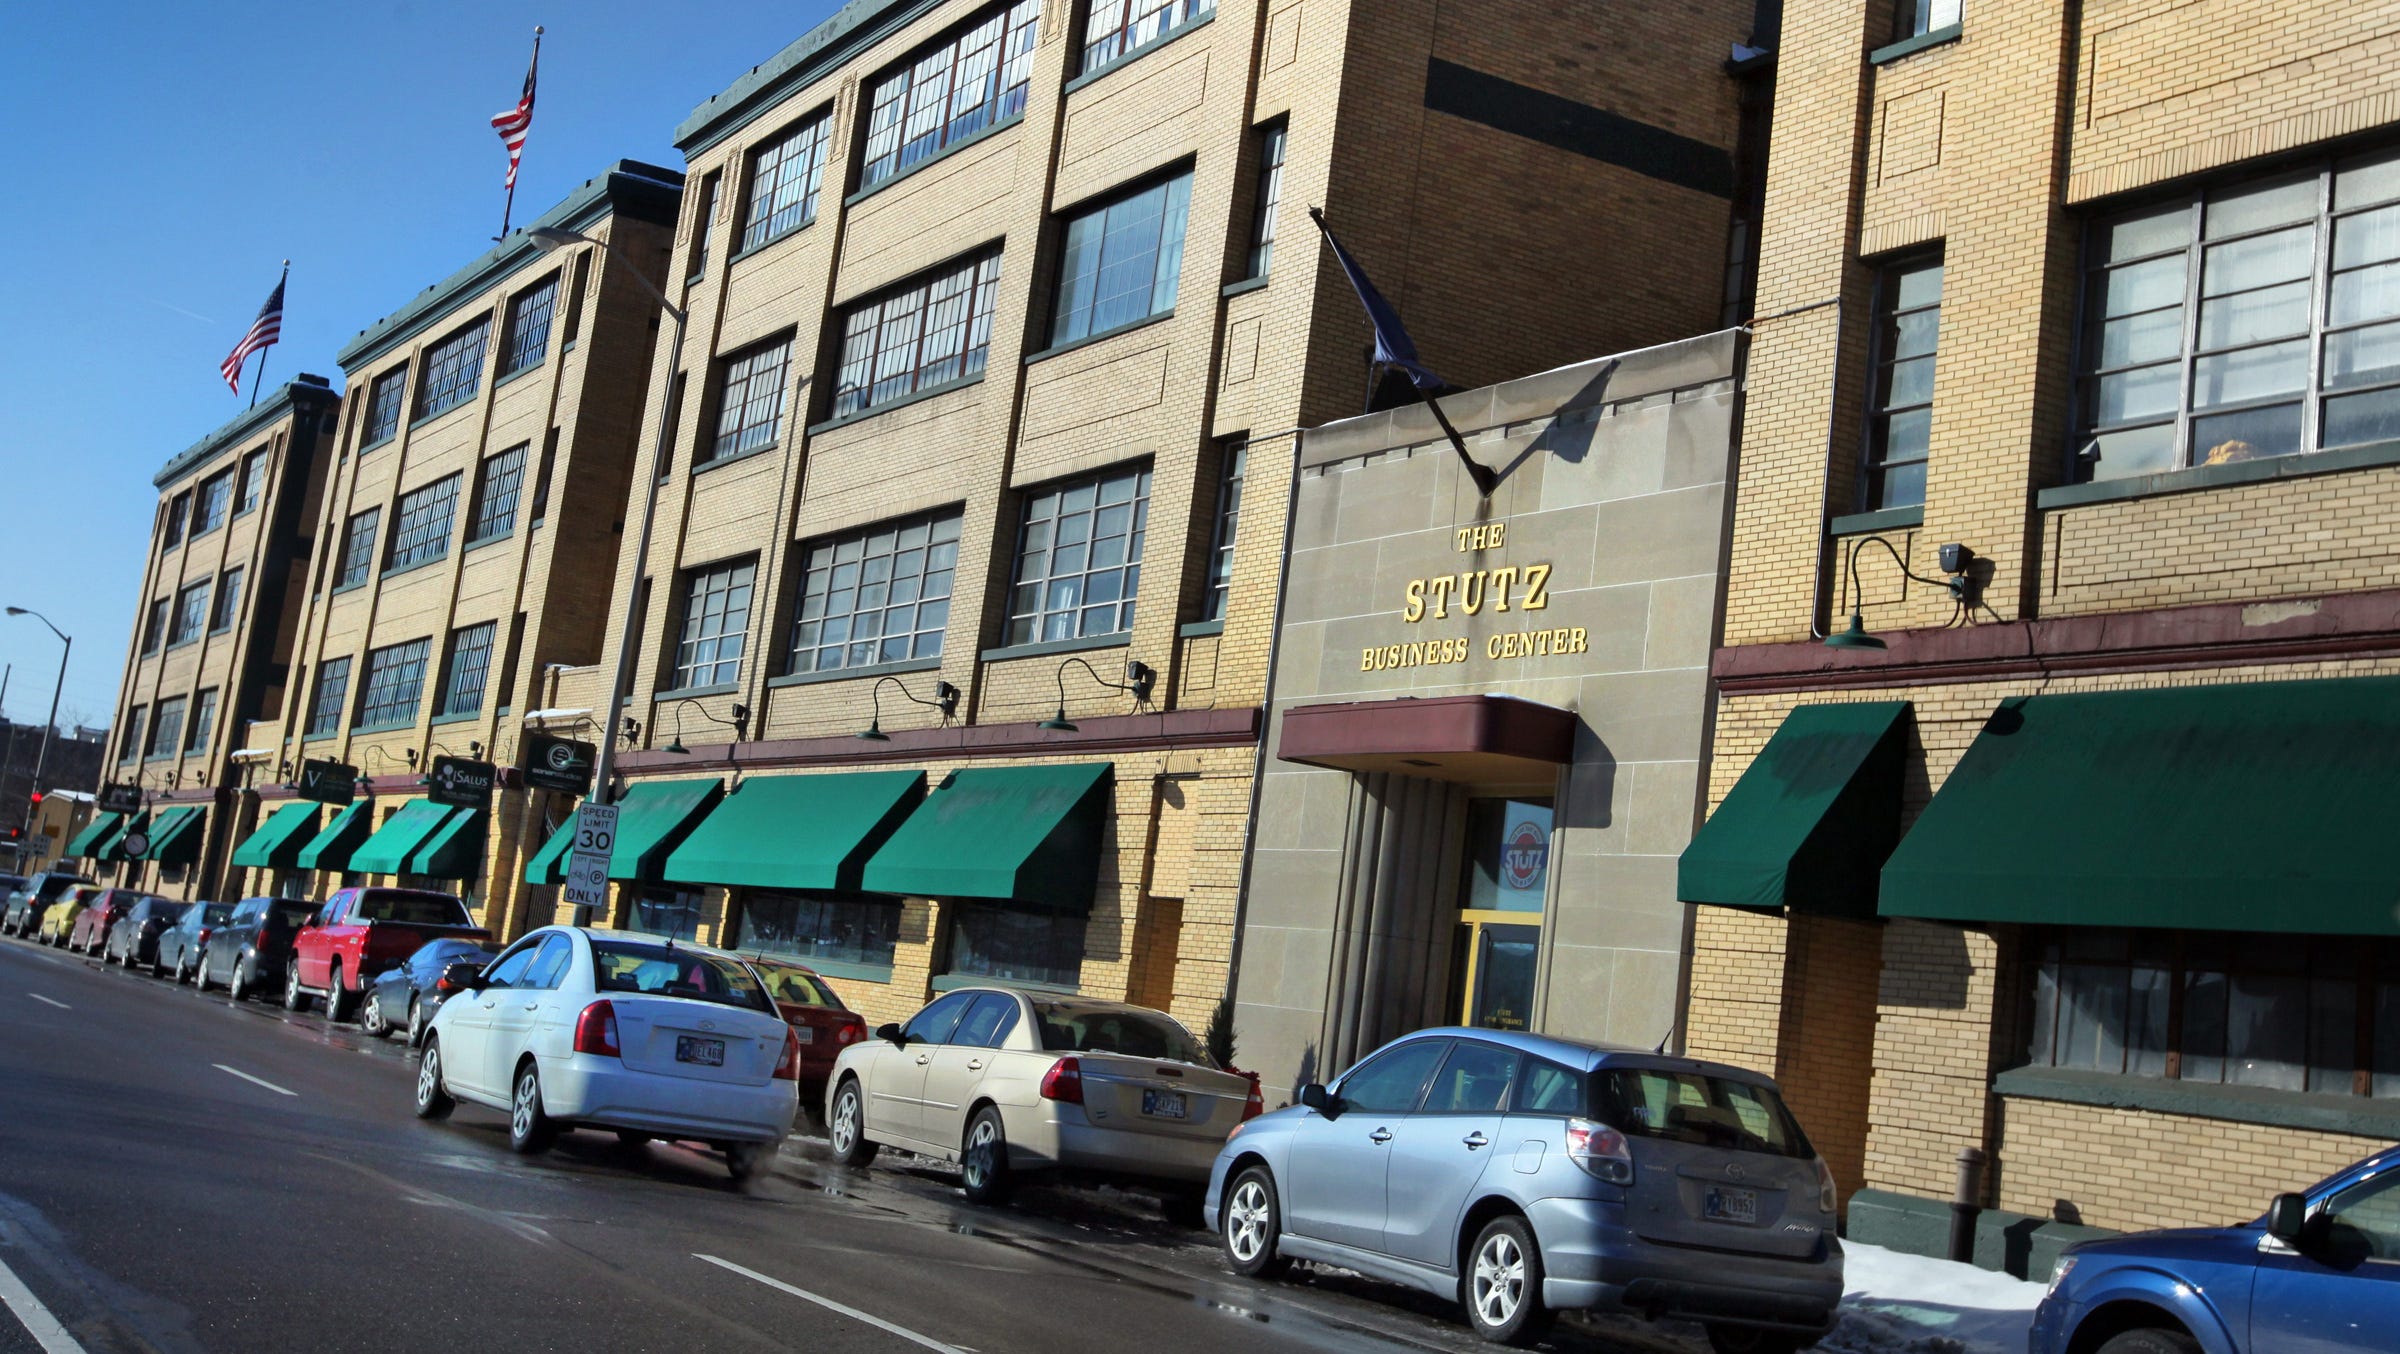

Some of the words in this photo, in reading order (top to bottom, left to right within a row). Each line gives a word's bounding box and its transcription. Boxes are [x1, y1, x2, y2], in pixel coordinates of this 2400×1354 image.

[1458, 523, 1505, 552] THE
[1404, 563, 1552, 623] STUTZ
[1361, 637, 1469, 672] BUSINESS
[1487, 627, 1588, 660] CENTER
[307, 770, 322, 788] V
[583, 807, 615, 818] SPEED
[584, 818, 610, 828] LIMIT
[580, 829, 610, 850] 30
[574, 855, 588, 863] LEFT
[567, 888, 600, 903] ONLY
